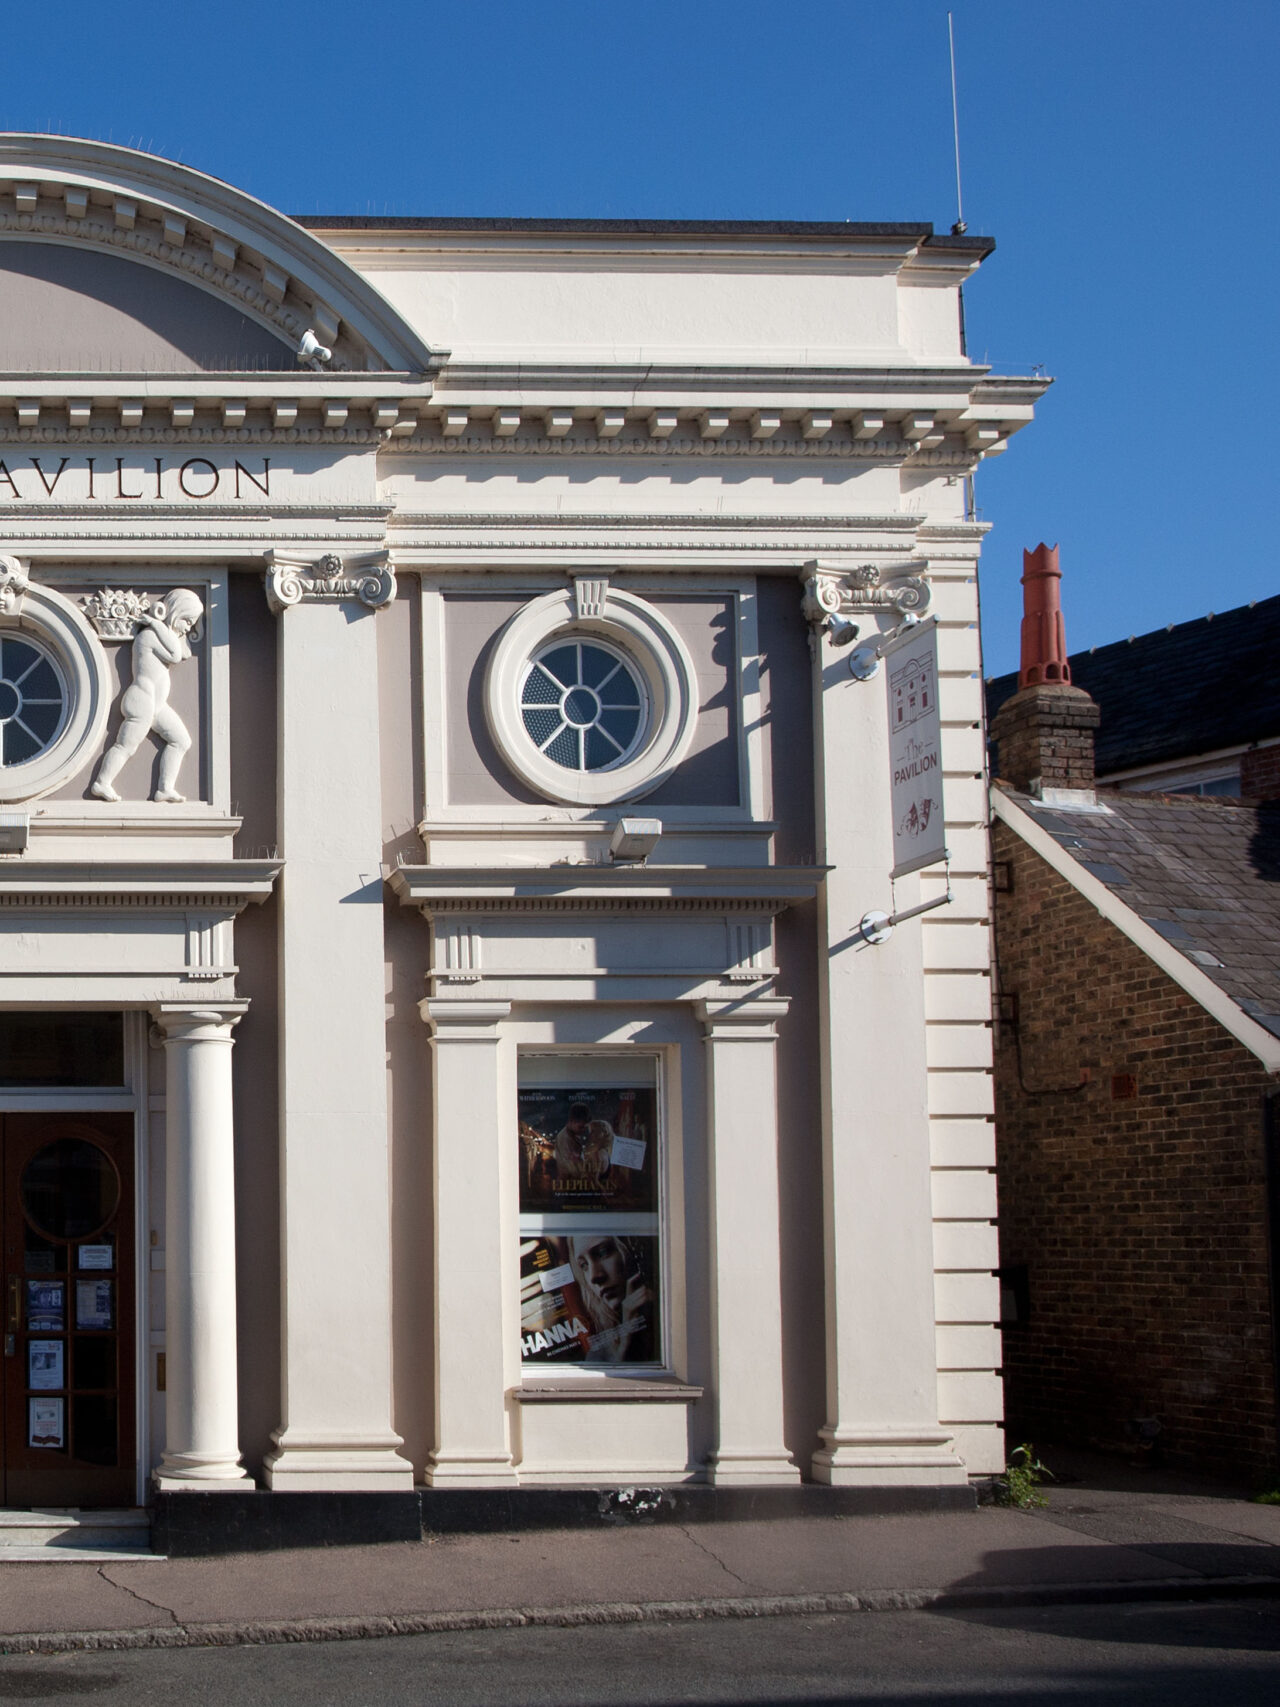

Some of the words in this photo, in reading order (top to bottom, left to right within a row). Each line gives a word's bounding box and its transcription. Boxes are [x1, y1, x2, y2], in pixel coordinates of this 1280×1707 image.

[904, 737, 924, 760] The
[894, 752, 938, 786] PAVILION
[521, 1317, 588, 1357] HANNA
